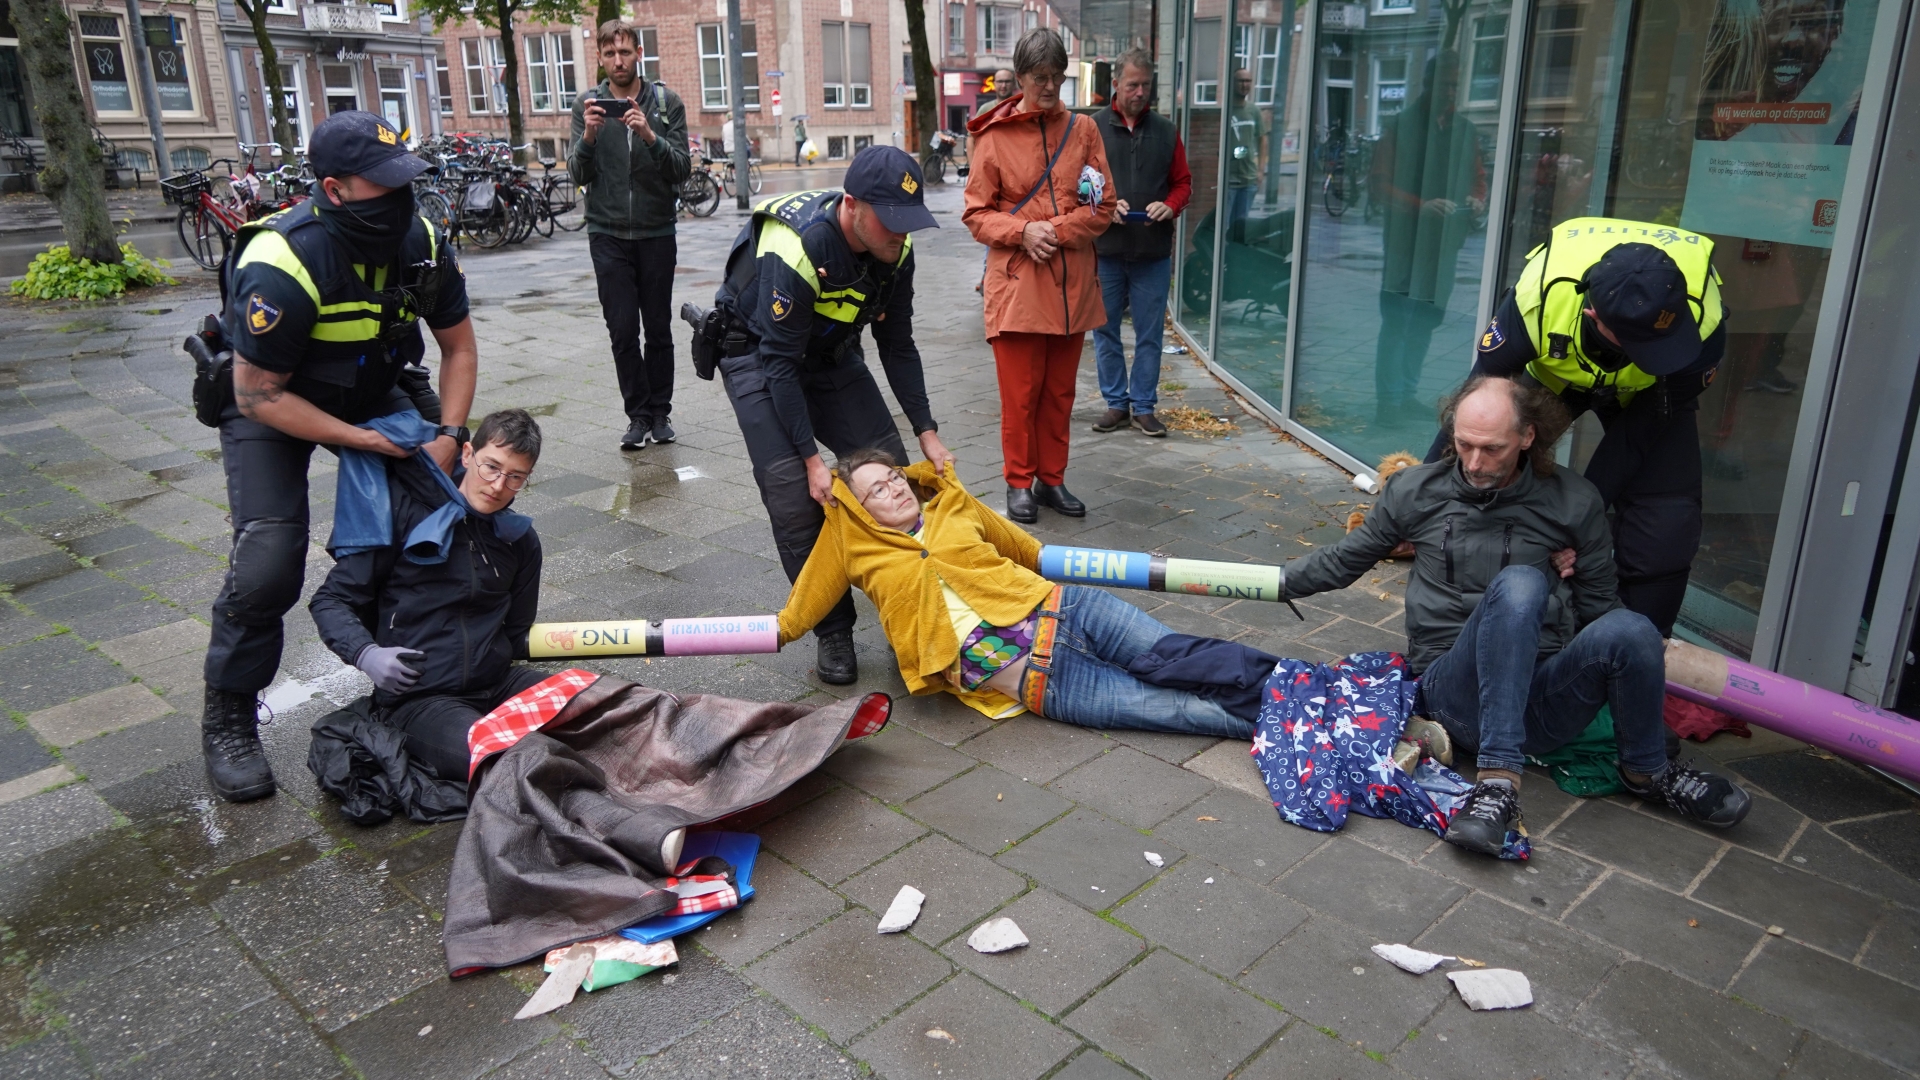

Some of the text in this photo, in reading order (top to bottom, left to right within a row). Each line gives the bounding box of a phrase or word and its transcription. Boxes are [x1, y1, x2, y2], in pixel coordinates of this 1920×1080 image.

[1716, 107, 1827, 121] Wij werken op afspraak
[1764, 170, 1776, 178] hoe
[1566, 226, 1700, 246] POLITIE
[1064, 550, 1128, 580] NEE!
[1215, 584, 1263, 600] ING
[748, 622, 768, 632] ING
[582, 628, 630, 646] ING
[1848, 732, 1878, 749] ING
